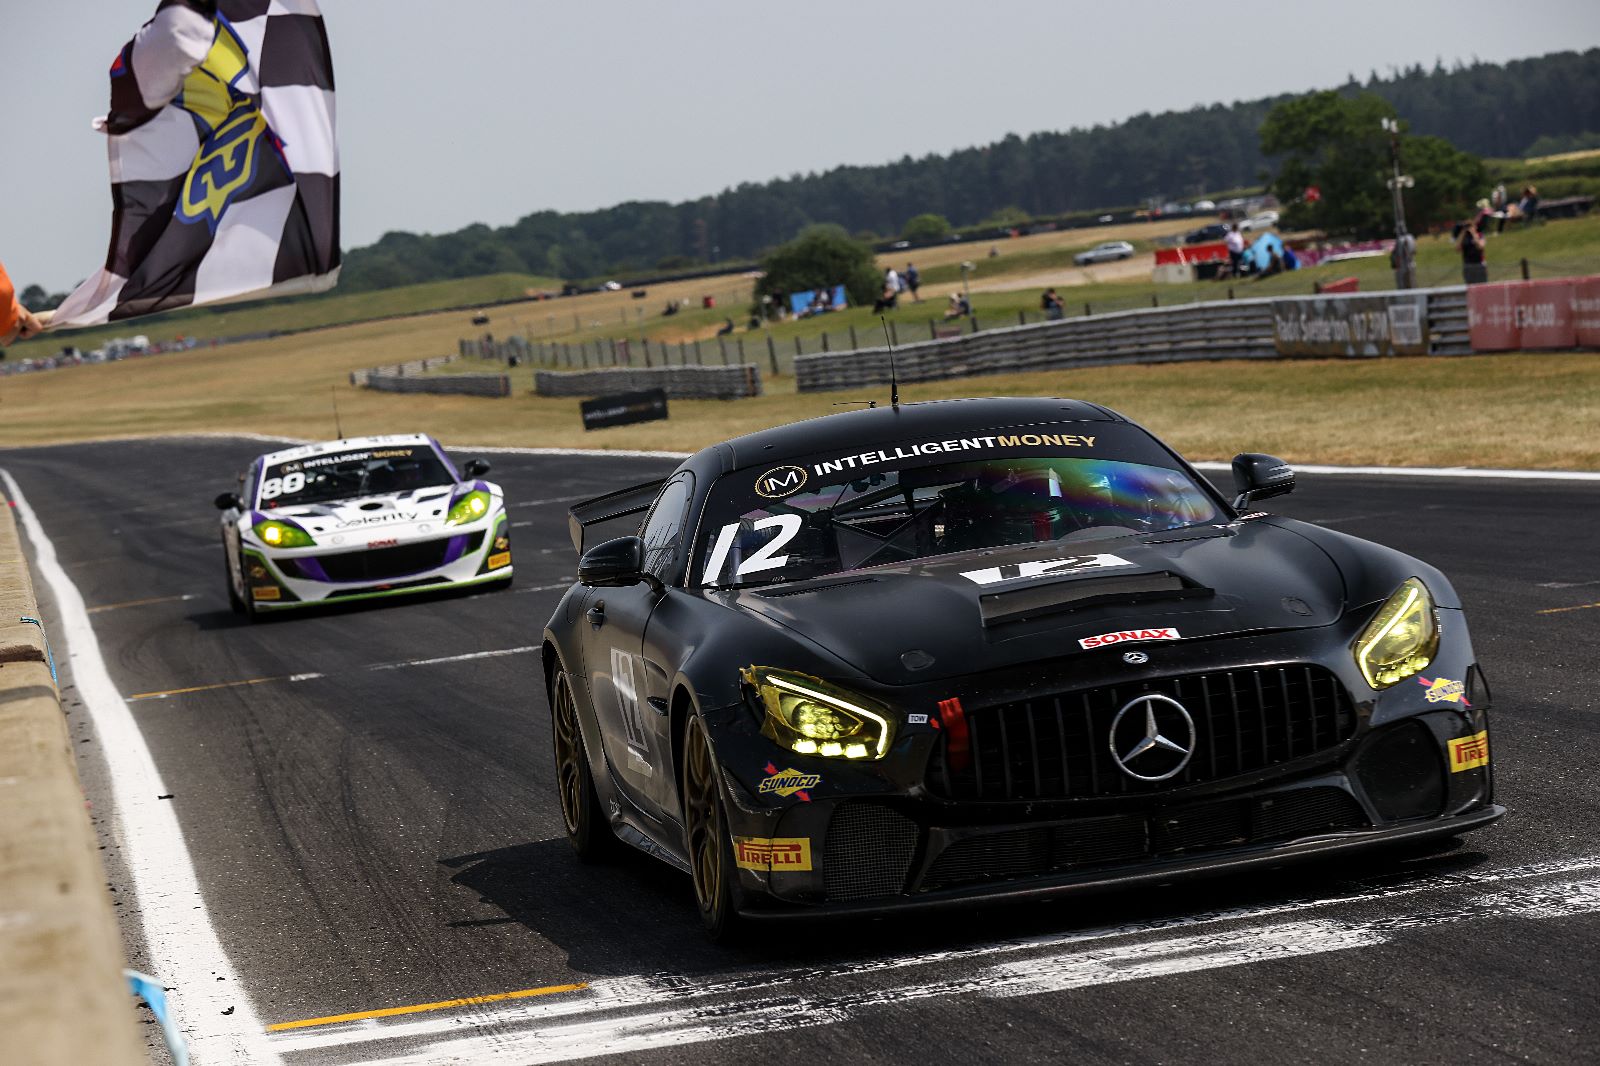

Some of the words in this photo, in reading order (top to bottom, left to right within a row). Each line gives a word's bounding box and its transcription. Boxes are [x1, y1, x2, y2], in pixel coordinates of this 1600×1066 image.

[702, 513, 803, 586] 12
[1083, 629, 1174, 647] SONAX
[910, 715, 927, 723] TOW
[760, 775, 819, 792] SUNOCO
[737, 841, 802, 865] PIRELLI
